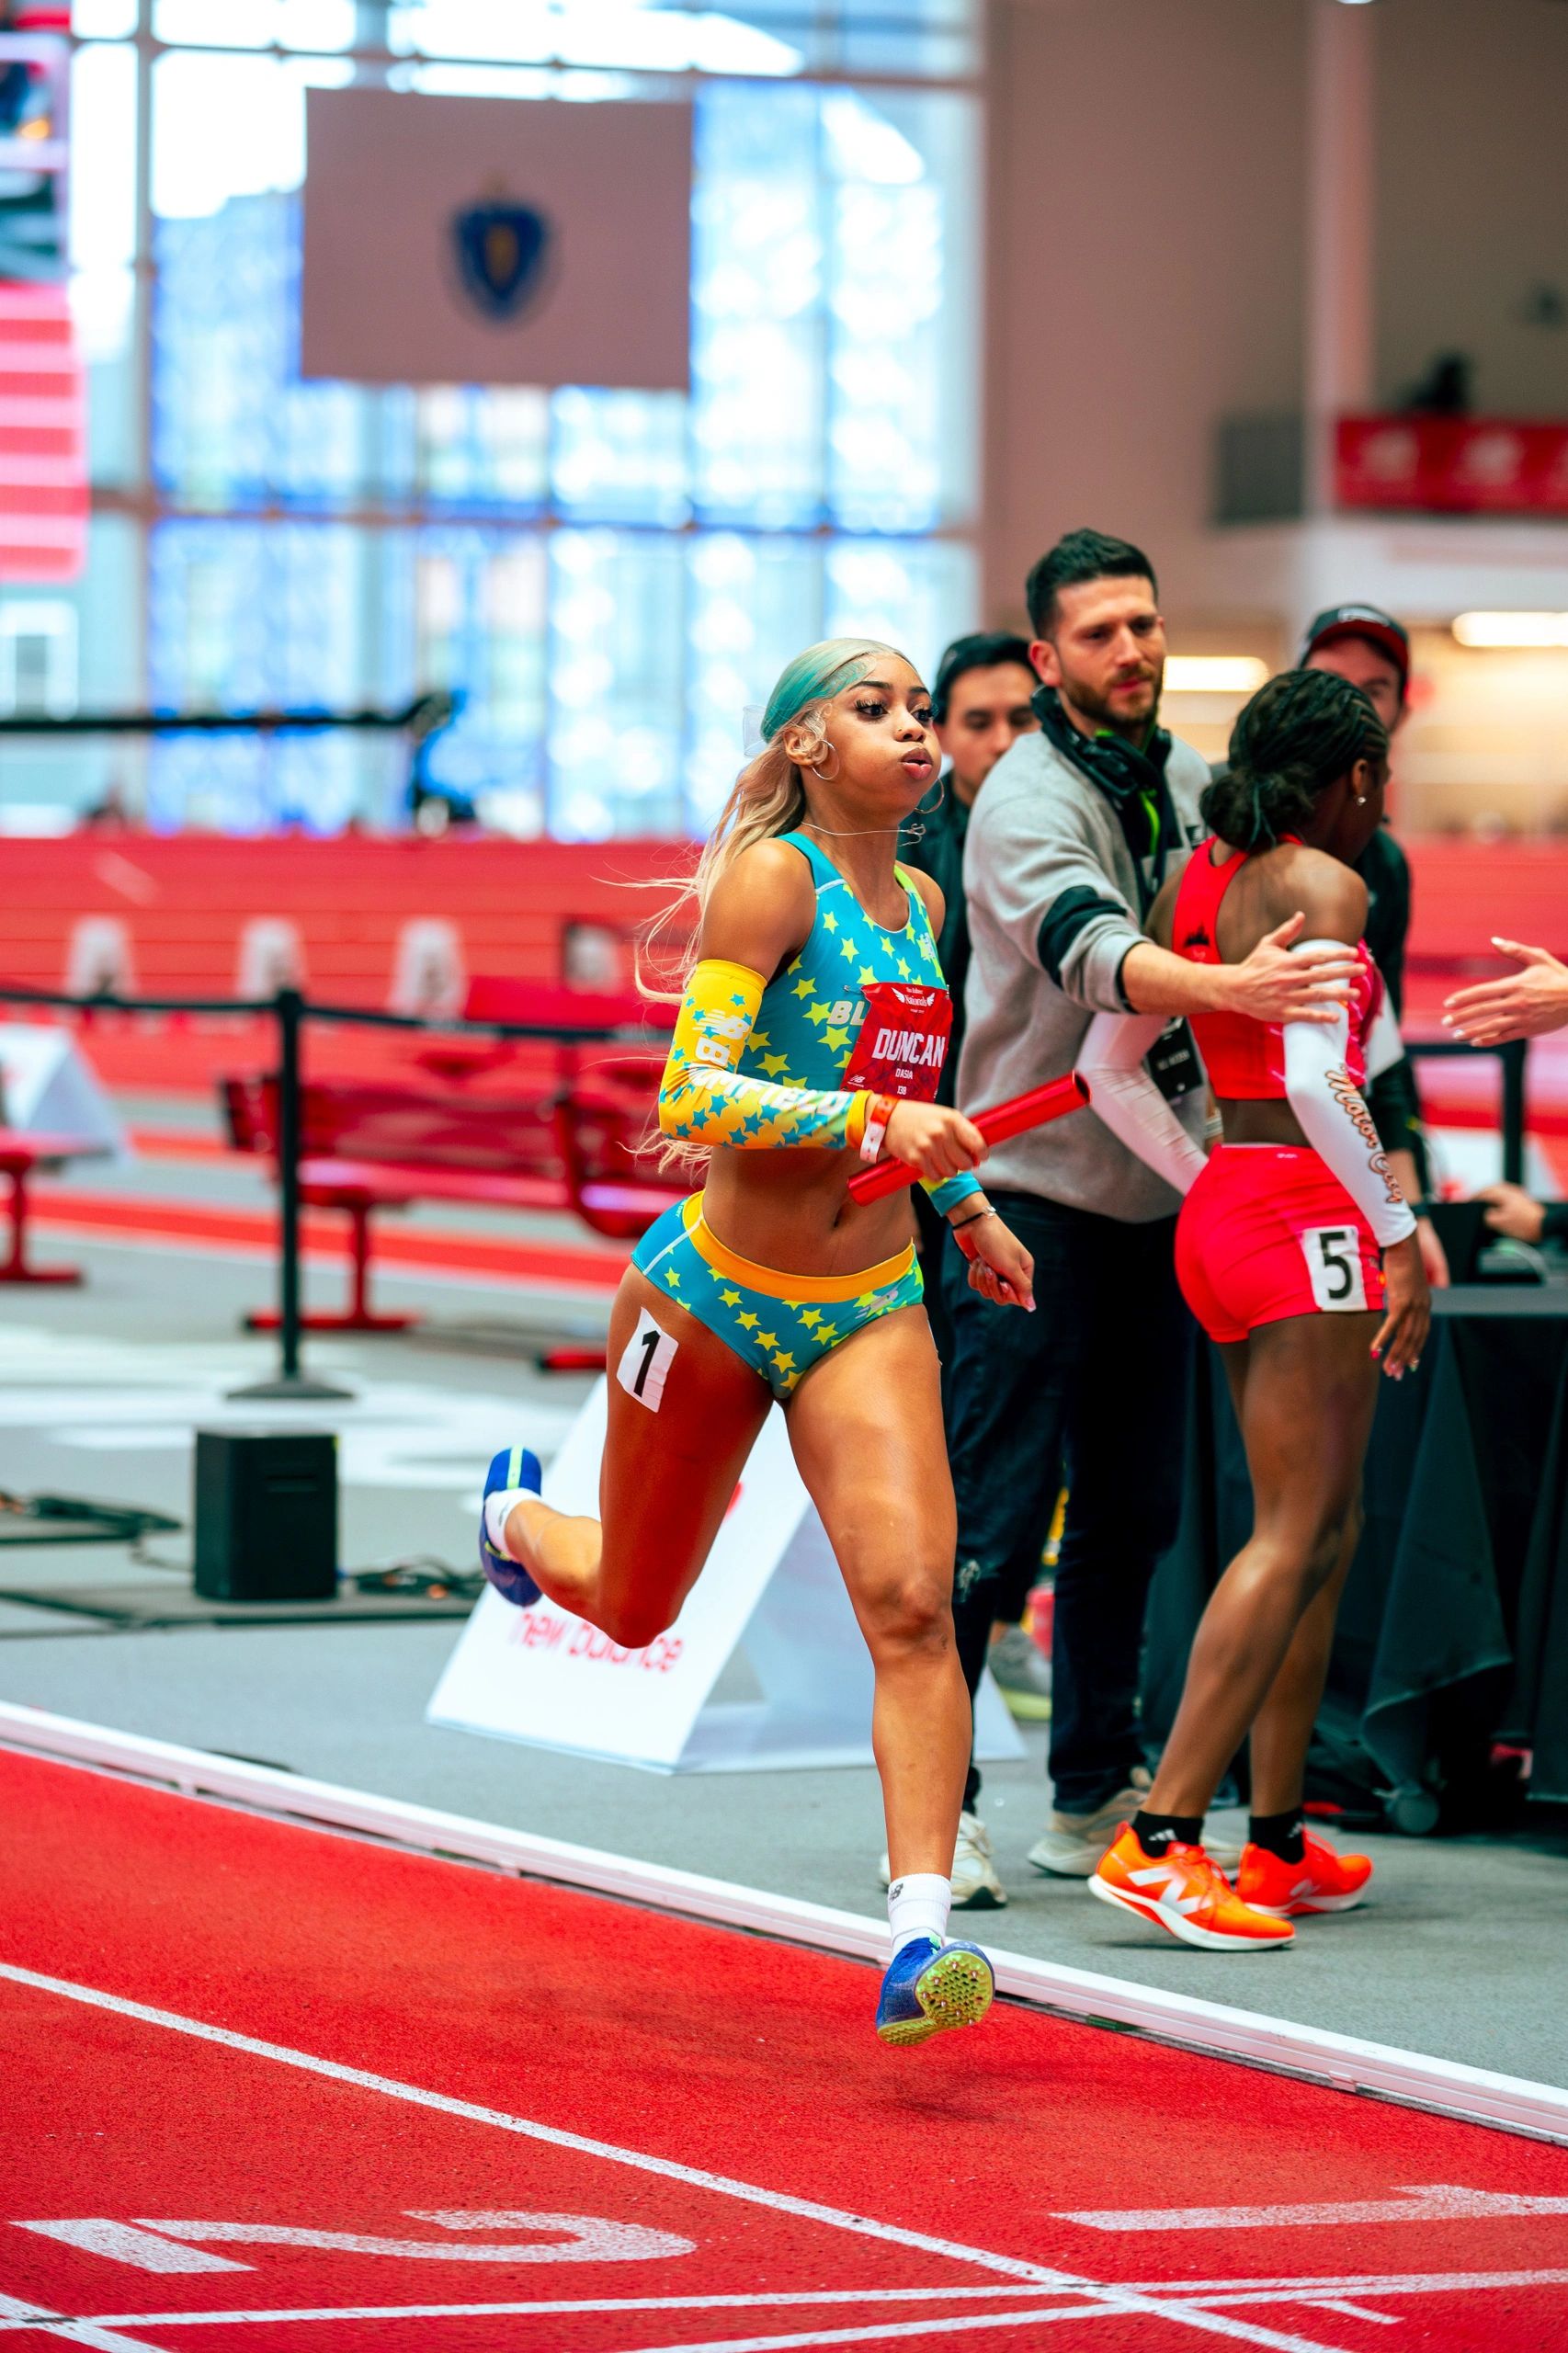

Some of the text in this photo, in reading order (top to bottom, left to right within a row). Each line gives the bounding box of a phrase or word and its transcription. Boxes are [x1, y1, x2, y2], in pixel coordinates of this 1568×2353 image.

[871, 1028, 946, 1067] DUNCAN
[895, 1068, 914, 1080] DASIA
[1318, 1231, 1353, 1300] 5
[632, 1329, 661, 1398] 1
